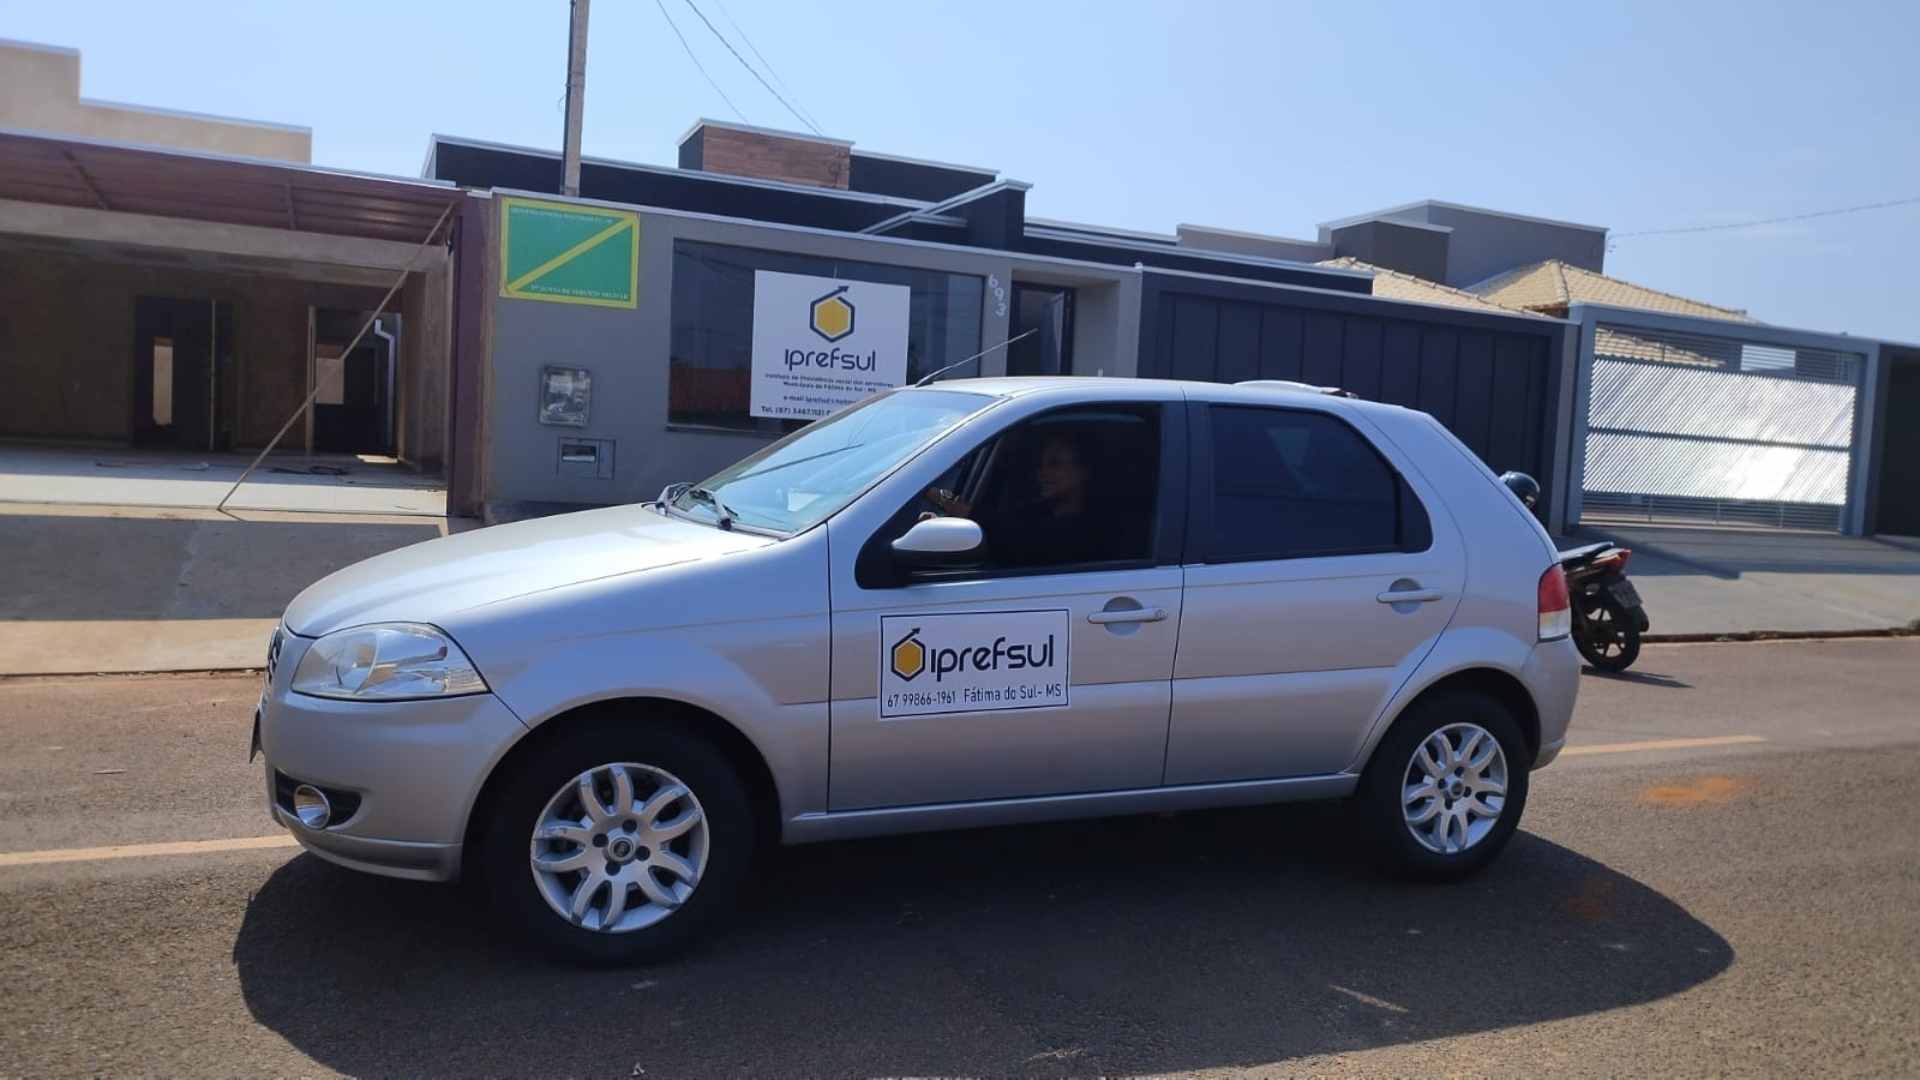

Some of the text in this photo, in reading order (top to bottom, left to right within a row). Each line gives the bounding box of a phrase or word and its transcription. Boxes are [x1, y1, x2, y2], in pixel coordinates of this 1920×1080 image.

[887, 694, 899, 708] 67
[903, 691, 956, 707] 99866-1961
[964, 686, 1001, 704] Fátima
[1004, 686, 1017, 701] do
[1046, 683, 1062, 698] MS
